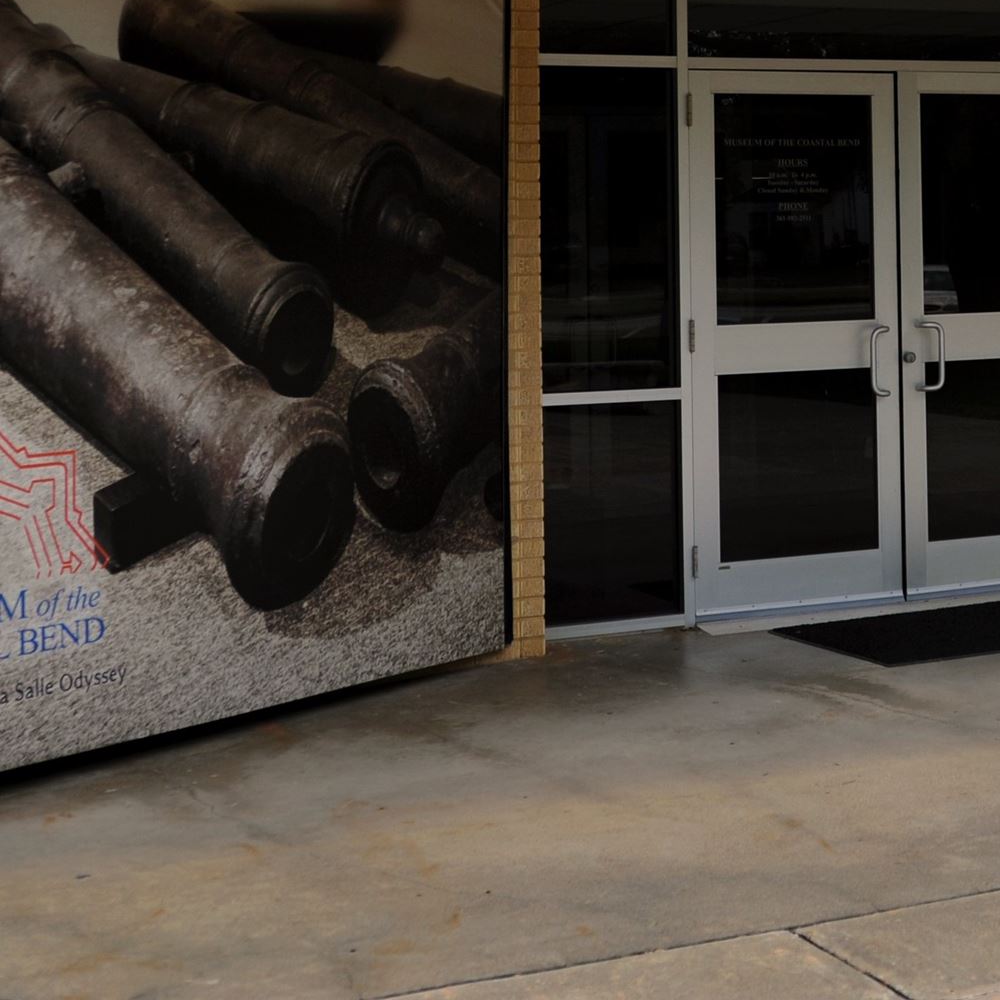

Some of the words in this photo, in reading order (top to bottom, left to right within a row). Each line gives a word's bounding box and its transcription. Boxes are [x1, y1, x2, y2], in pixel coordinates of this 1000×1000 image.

[723, 138, 763, 147] MUSEUM
[764, 138, 776, 147] OF
[778, 138, 795, 147] THE
[797, 138, 835, 147] COASTAL
[838, 138, 861, 147] BEND
[778, 158, 808, 168] HOURS
[778, 201, 808, 211] PHONE
[37, 588, 65, 621] of
[66, 586, 101, 612] the
[18, 616, 107, 657] BEND
[15, 678, 54, 701] Salle
[60, 663, 127, 692] Odyssey
